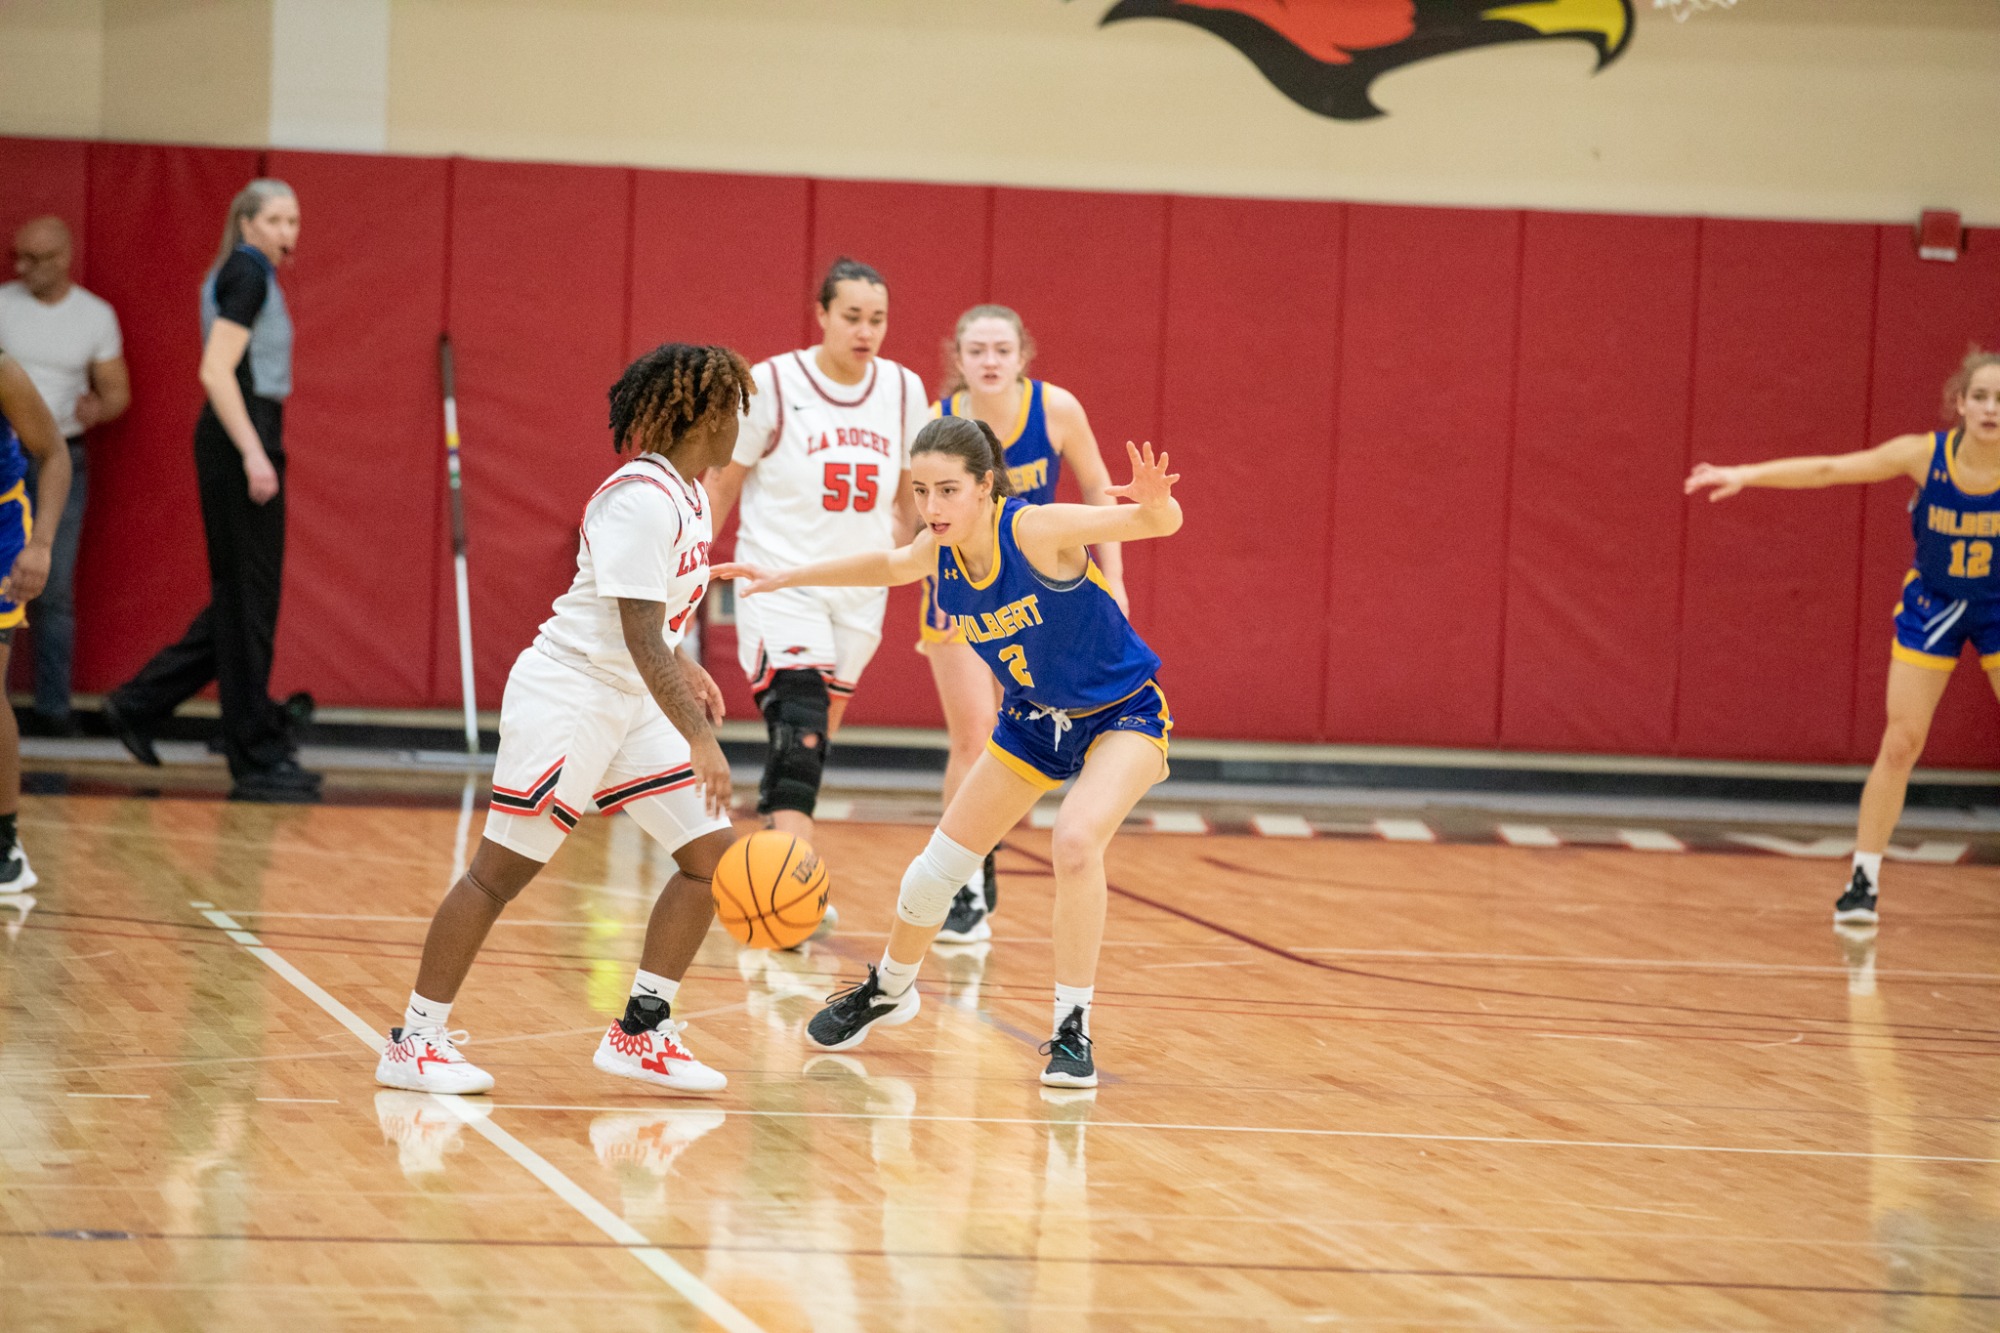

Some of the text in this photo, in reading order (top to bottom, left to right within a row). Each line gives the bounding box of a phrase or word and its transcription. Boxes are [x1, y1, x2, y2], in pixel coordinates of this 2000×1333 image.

[807, 427, 891, 458] LA ROCHE
[822, 461, 880, 513] 55
[1947, 539, 1994, 579] 12
[949, 593, 1044, 644] HILBERT
[997, 643, 1036, 689] 2
